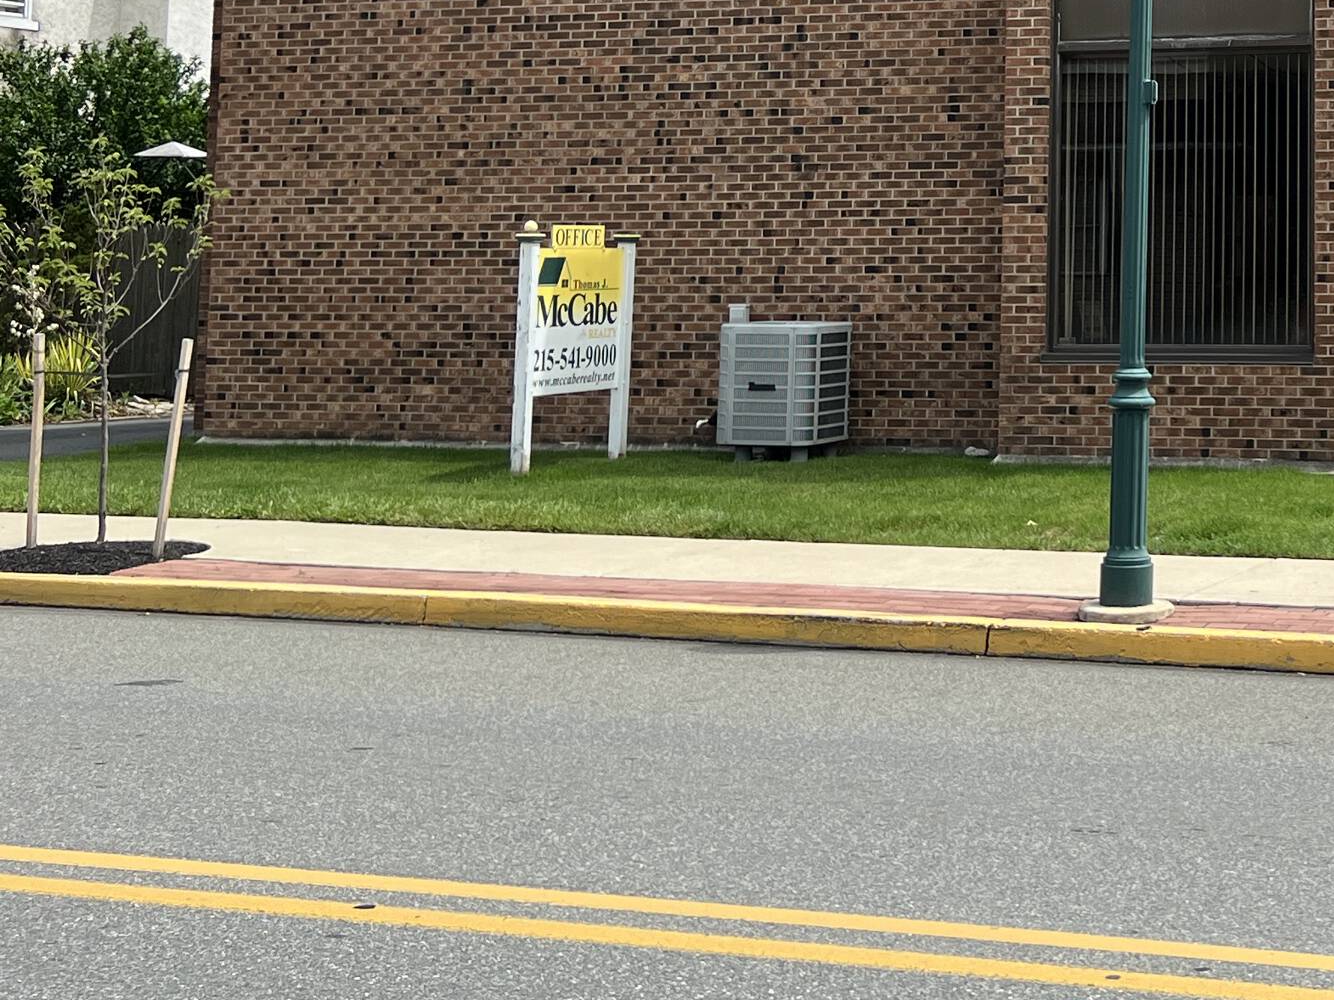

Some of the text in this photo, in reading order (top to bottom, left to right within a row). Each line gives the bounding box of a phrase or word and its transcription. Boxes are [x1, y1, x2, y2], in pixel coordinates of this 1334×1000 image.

[556, 229, 602, 246] OFFICE
[573, 277, 609, 290] Thomas J.
[536, 292, 617, 328] McCabe
[588, 328, 616, 338] REALTY
[533, 344, 616, 372] 215-541-9000
[532, 371, 615, 387] www.mccaberealty.net
